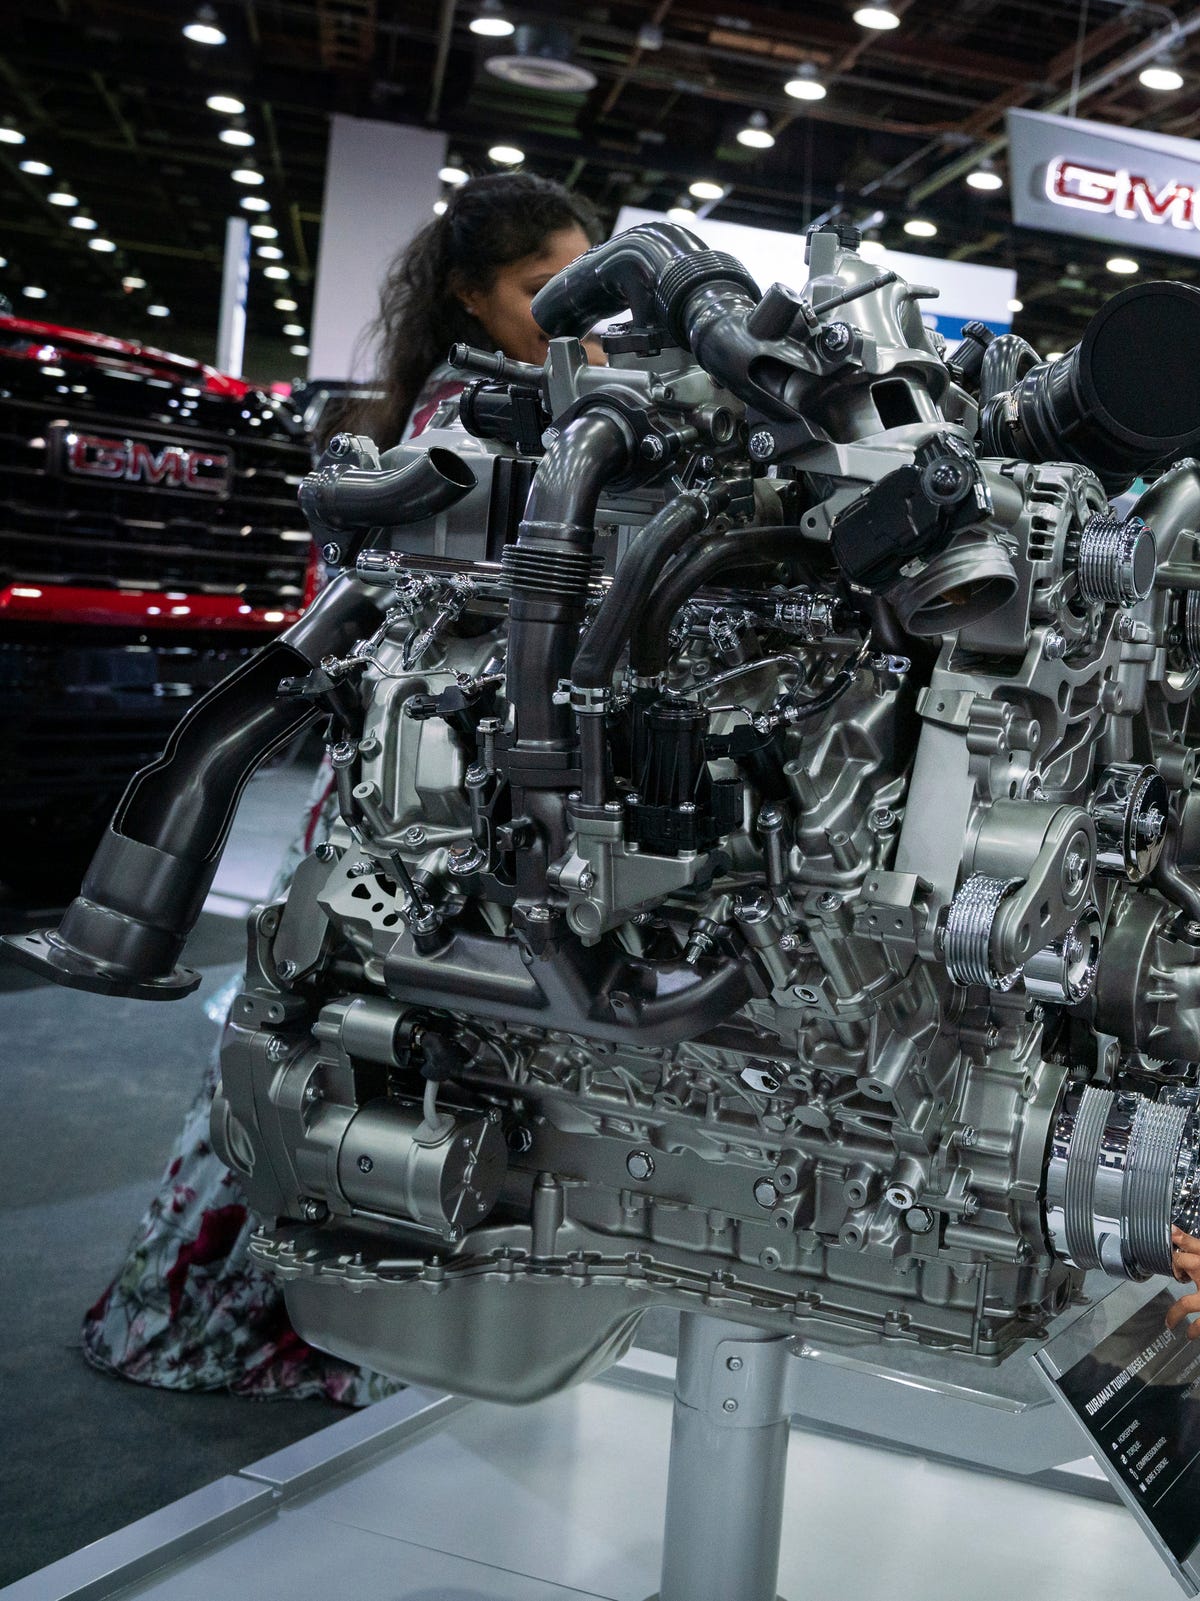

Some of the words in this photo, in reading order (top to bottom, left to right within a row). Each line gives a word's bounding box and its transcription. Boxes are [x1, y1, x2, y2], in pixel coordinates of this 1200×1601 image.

[67, 433, 232, 492] GMC
[1084, 1384, 1115, 1415] DURAMAX
[1109, 1369, 1131, 1392] TURBO
[1125, 1354, 1147, 1377] DIESEL
